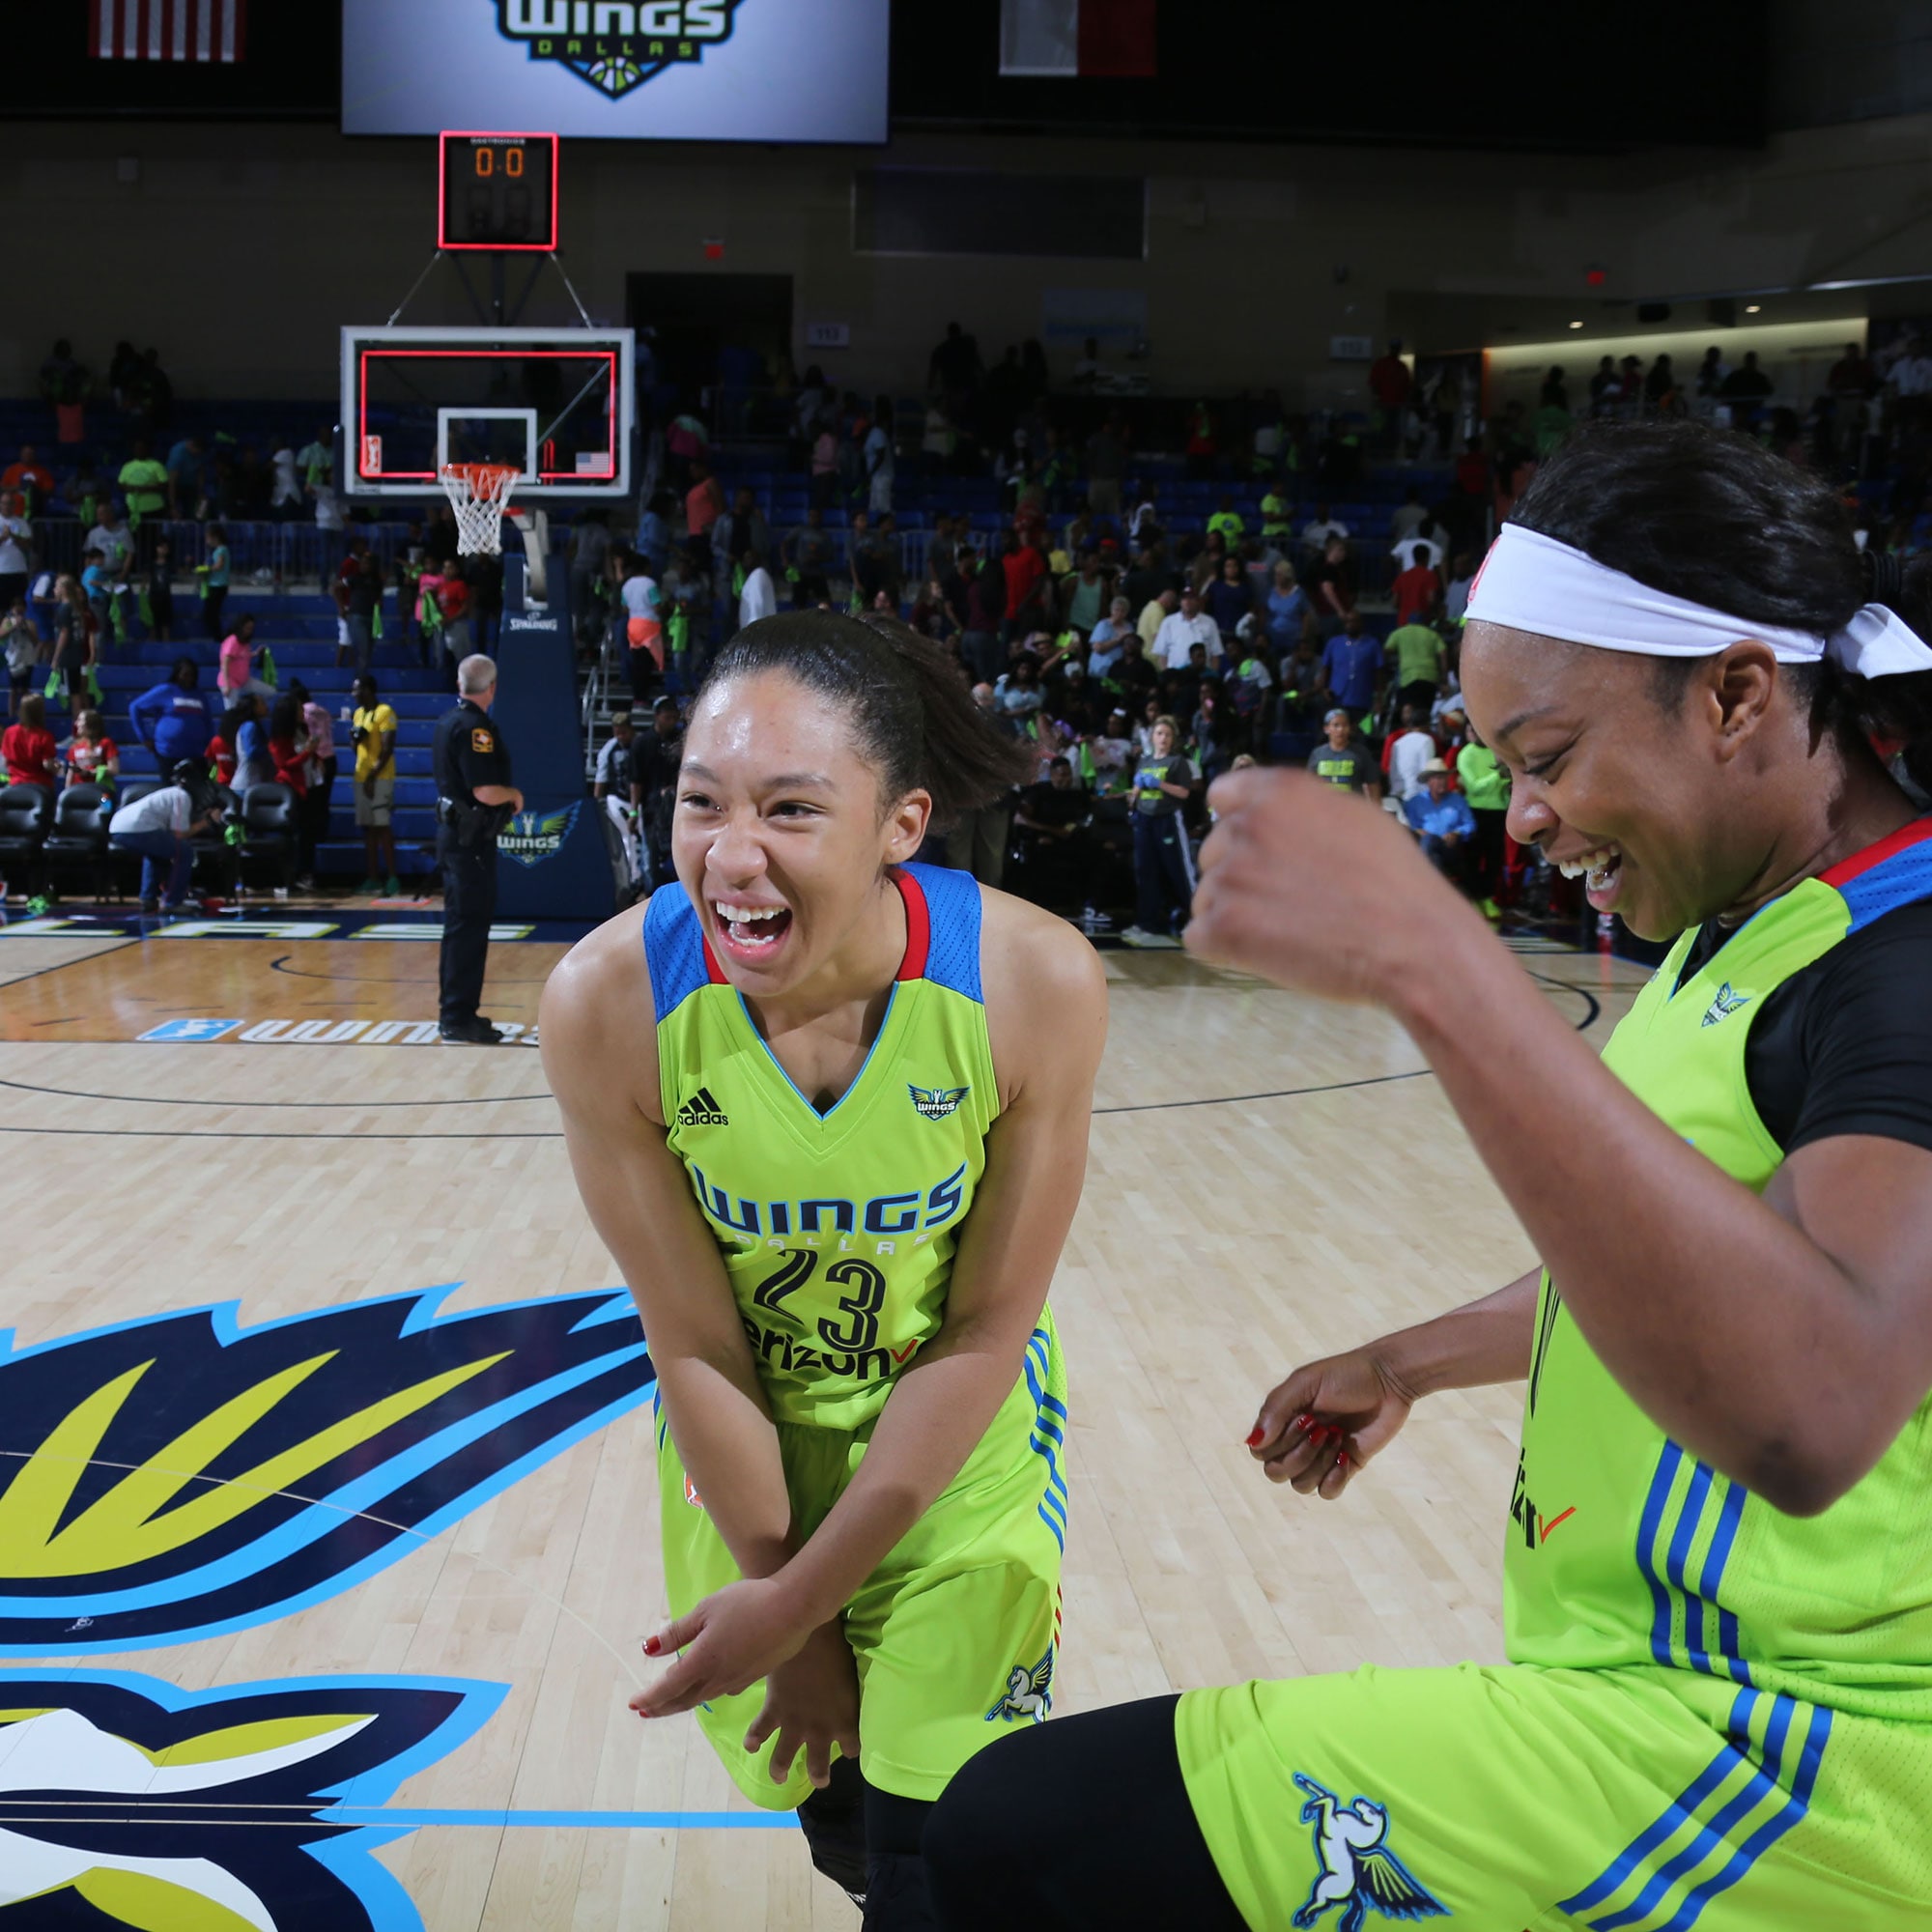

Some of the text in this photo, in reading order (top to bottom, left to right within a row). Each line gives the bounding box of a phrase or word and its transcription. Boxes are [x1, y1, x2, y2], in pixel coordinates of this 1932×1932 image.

[506, 0, 725, 37] WINGS
[537, 39, 693, 57] DALLAS
[497, 835, 560, 849] WINGS
[677, 1111, 729, 1126] adidas
[918, 1101, 956, 1112] WINGS
[691, 1159, 968, 1237] WINGS
[753, 1249, 887, 1353] 23
[743, 1316, 892, 1380] erizon
